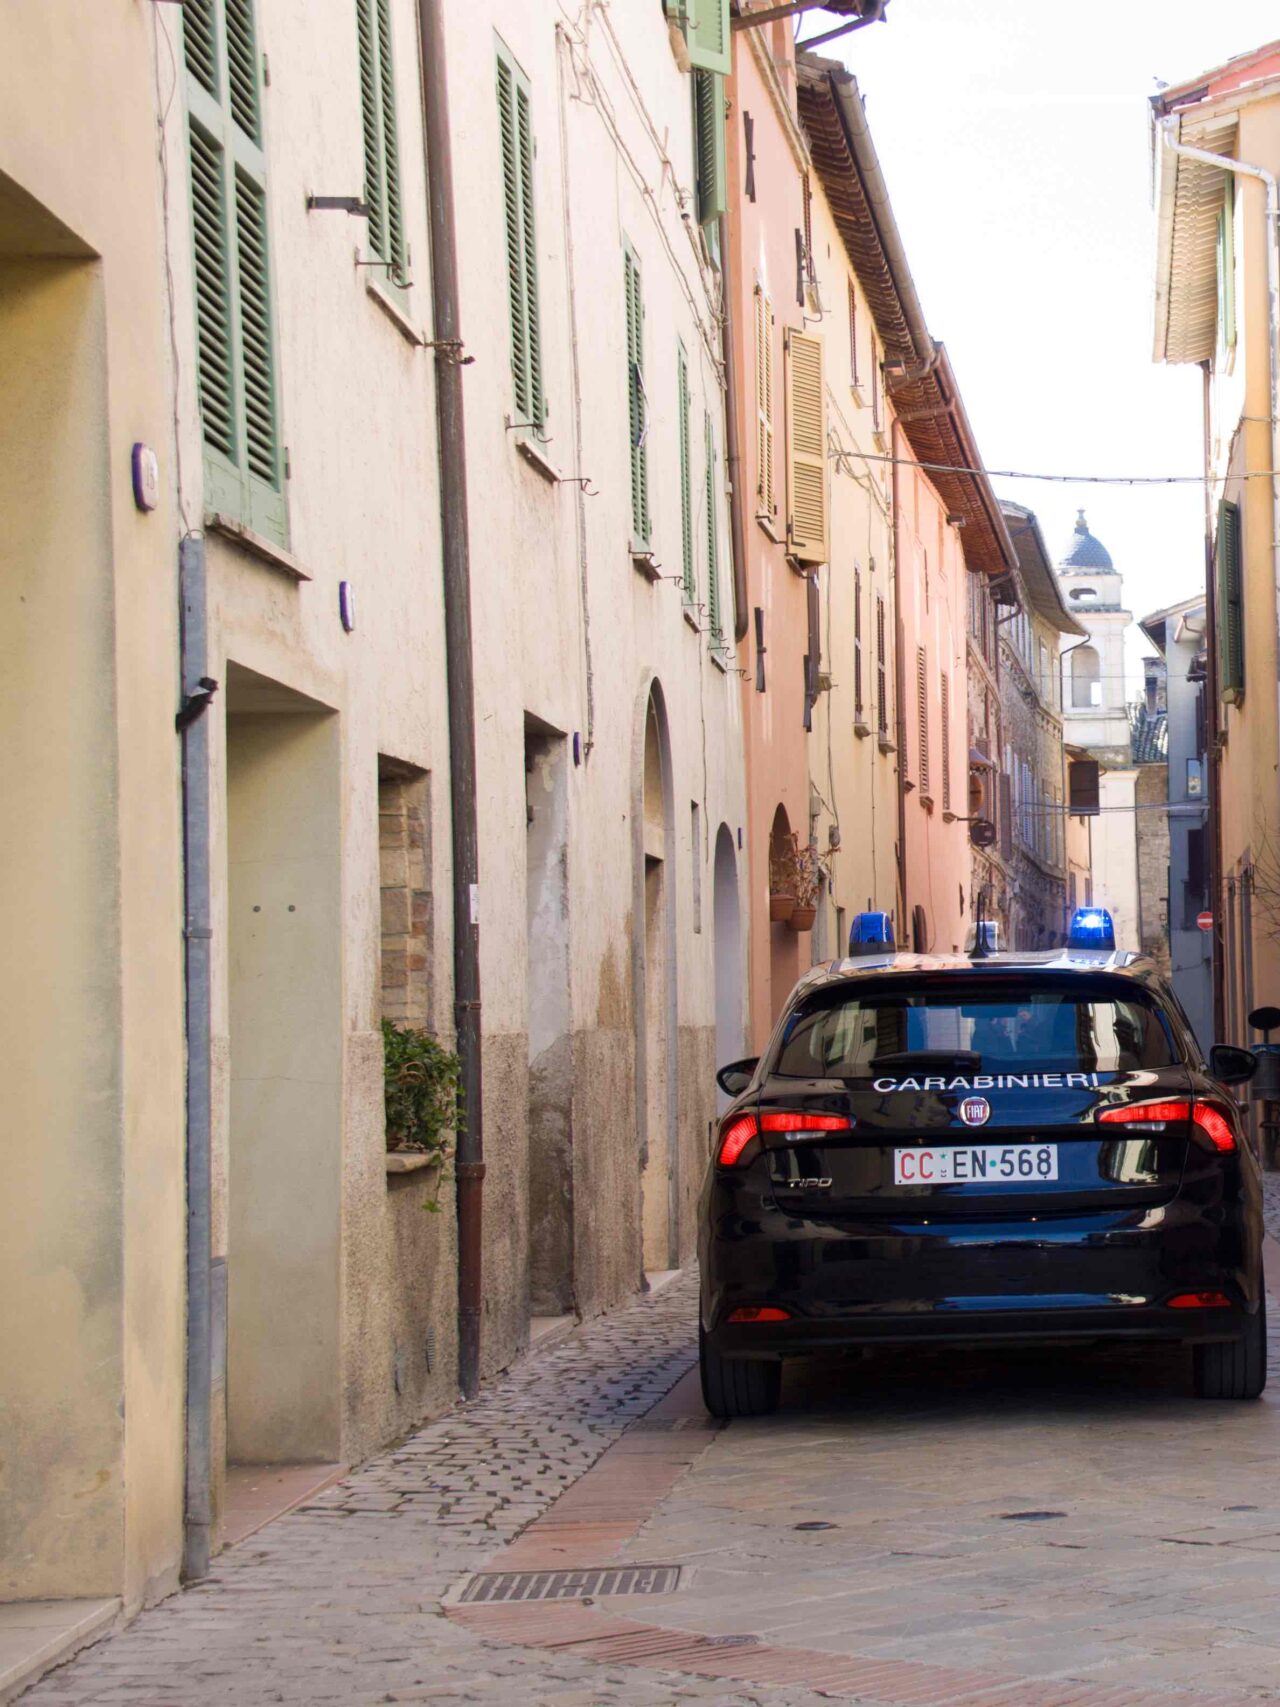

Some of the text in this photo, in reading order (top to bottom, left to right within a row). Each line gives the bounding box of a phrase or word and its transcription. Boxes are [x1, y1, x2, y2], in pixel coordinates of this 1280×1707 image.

[873, 1073, 1099, 1093] CARABINIERI
[966, 1105, 984, 1119] FIAT
[1000, 1149, 1051, 1176] 568
[787, 1178, 833, 1188] TIPO
